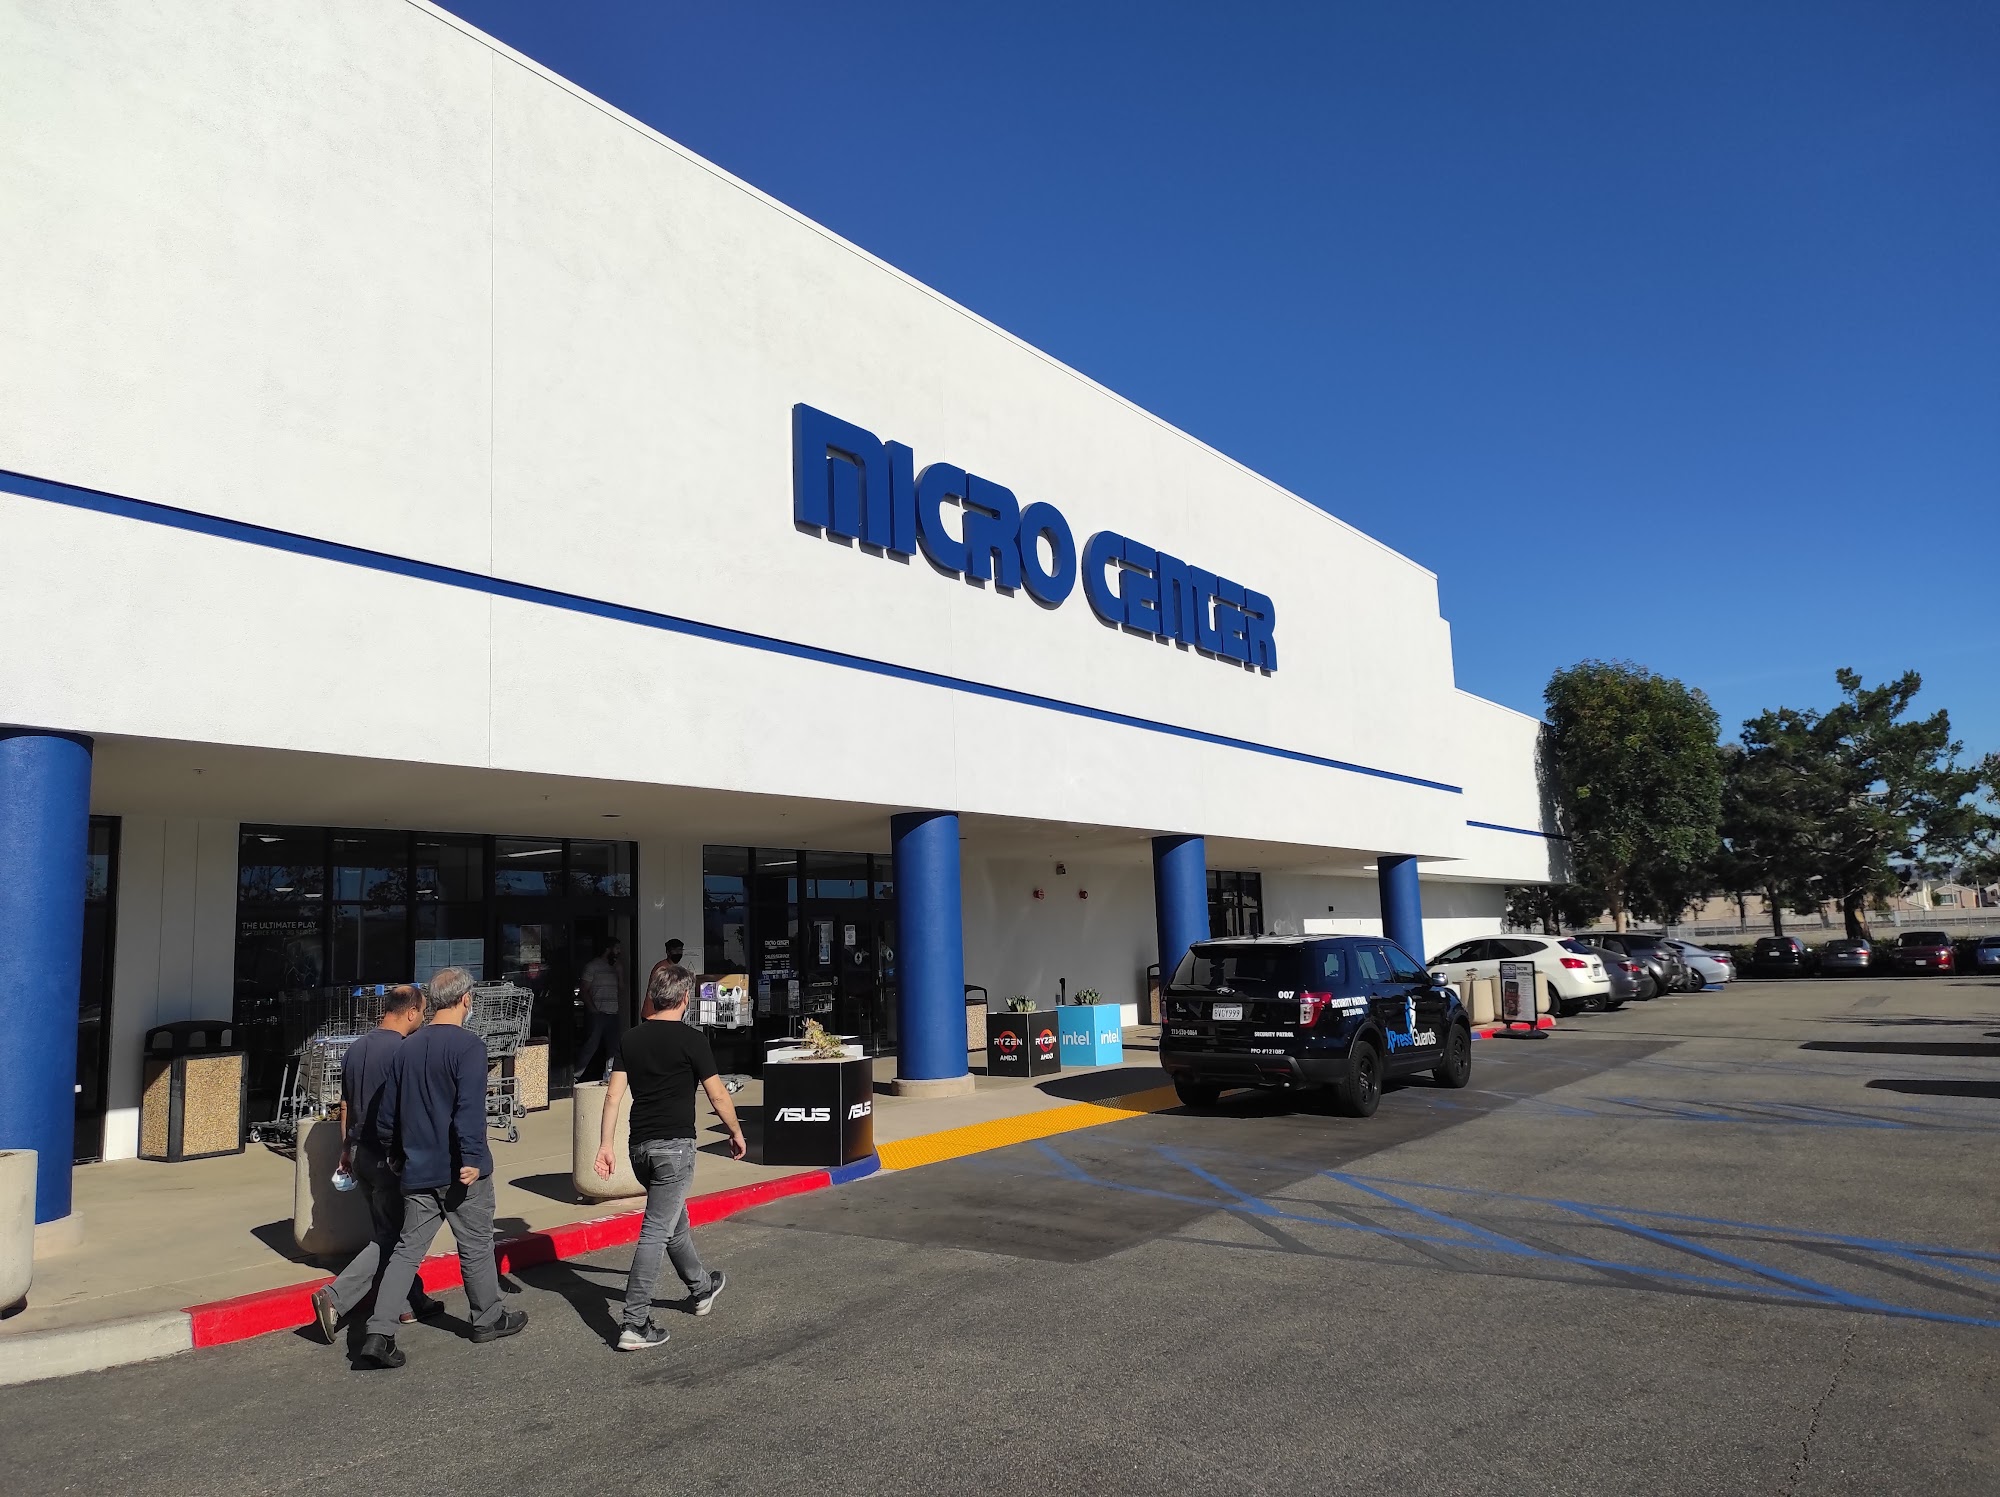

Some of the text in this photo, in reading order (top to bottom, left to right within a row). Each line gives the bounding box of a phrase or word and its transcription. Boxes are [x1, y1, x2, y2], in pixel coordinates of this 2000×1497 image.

[792, 402, 1278, 677] MICRO CENTER
[242, 921, 317, 930] THE ULTIMATE PLAY
[1278, 990, 1295, 999] 007
[1331, 995, 1368, 1009] SECURITY PATROL
[993, 1037, 1023, 1046] RYZEN
[1035, 1035, 1057, 1046] RYZEN
[1000, 1054, 1015, 1062] AMD
[1040, 1053, 1053, 1061] AMD
[774, 1107, 831, 1122] ASUS
[847, 1100, 872, 1120] ASUS
